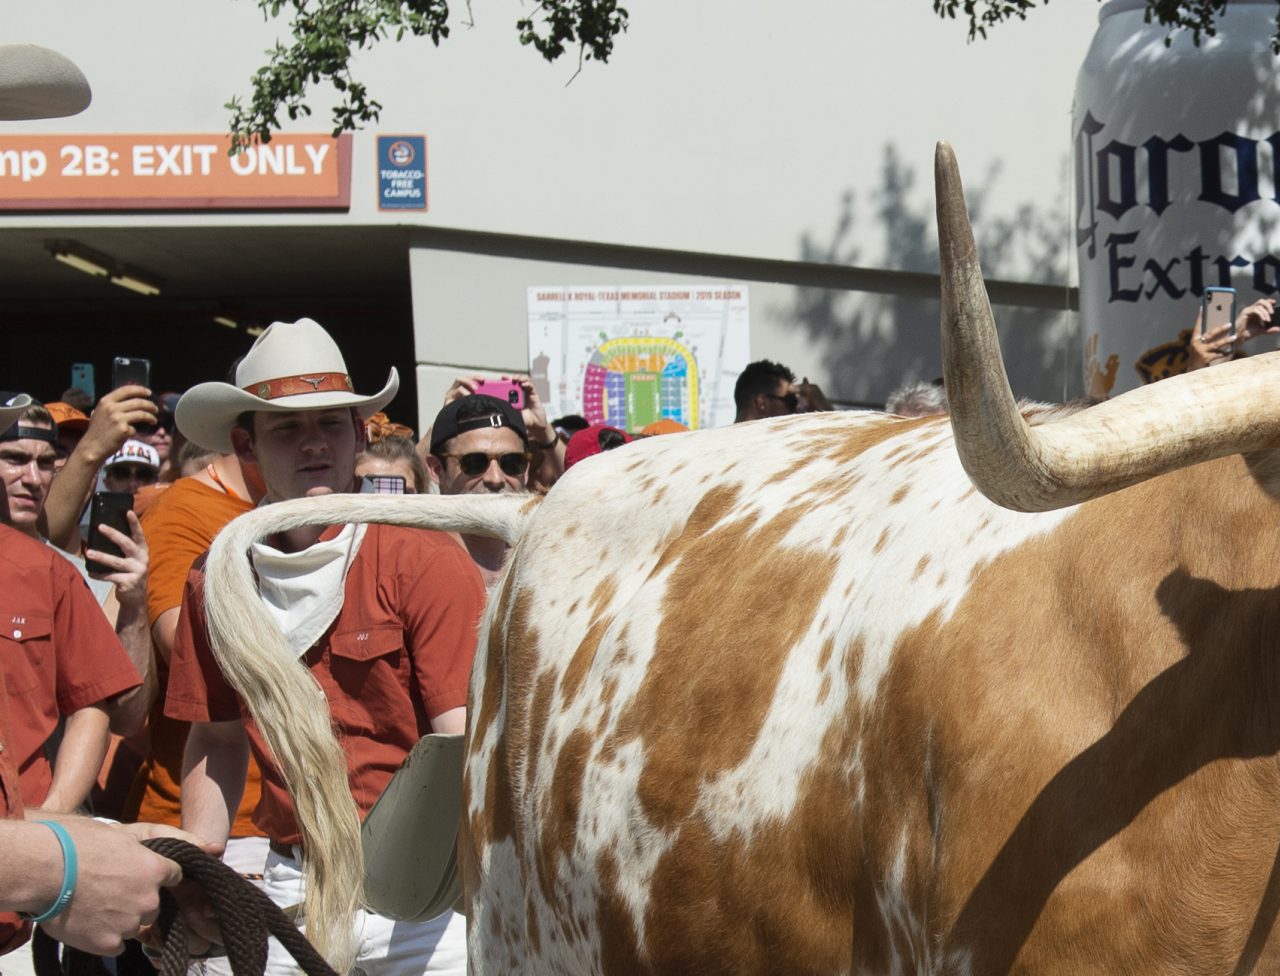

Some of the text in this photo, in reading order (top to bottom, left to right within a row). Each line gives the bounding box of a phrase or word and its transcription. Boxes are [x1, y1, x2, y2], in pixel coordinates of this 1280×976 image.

[60, 145, 119, 177] 2B:
[132, 144, 218, 176] EXIT
[230, 143, 330, 176] ONLY
[384, 188, 421, 198] CAMPUS
